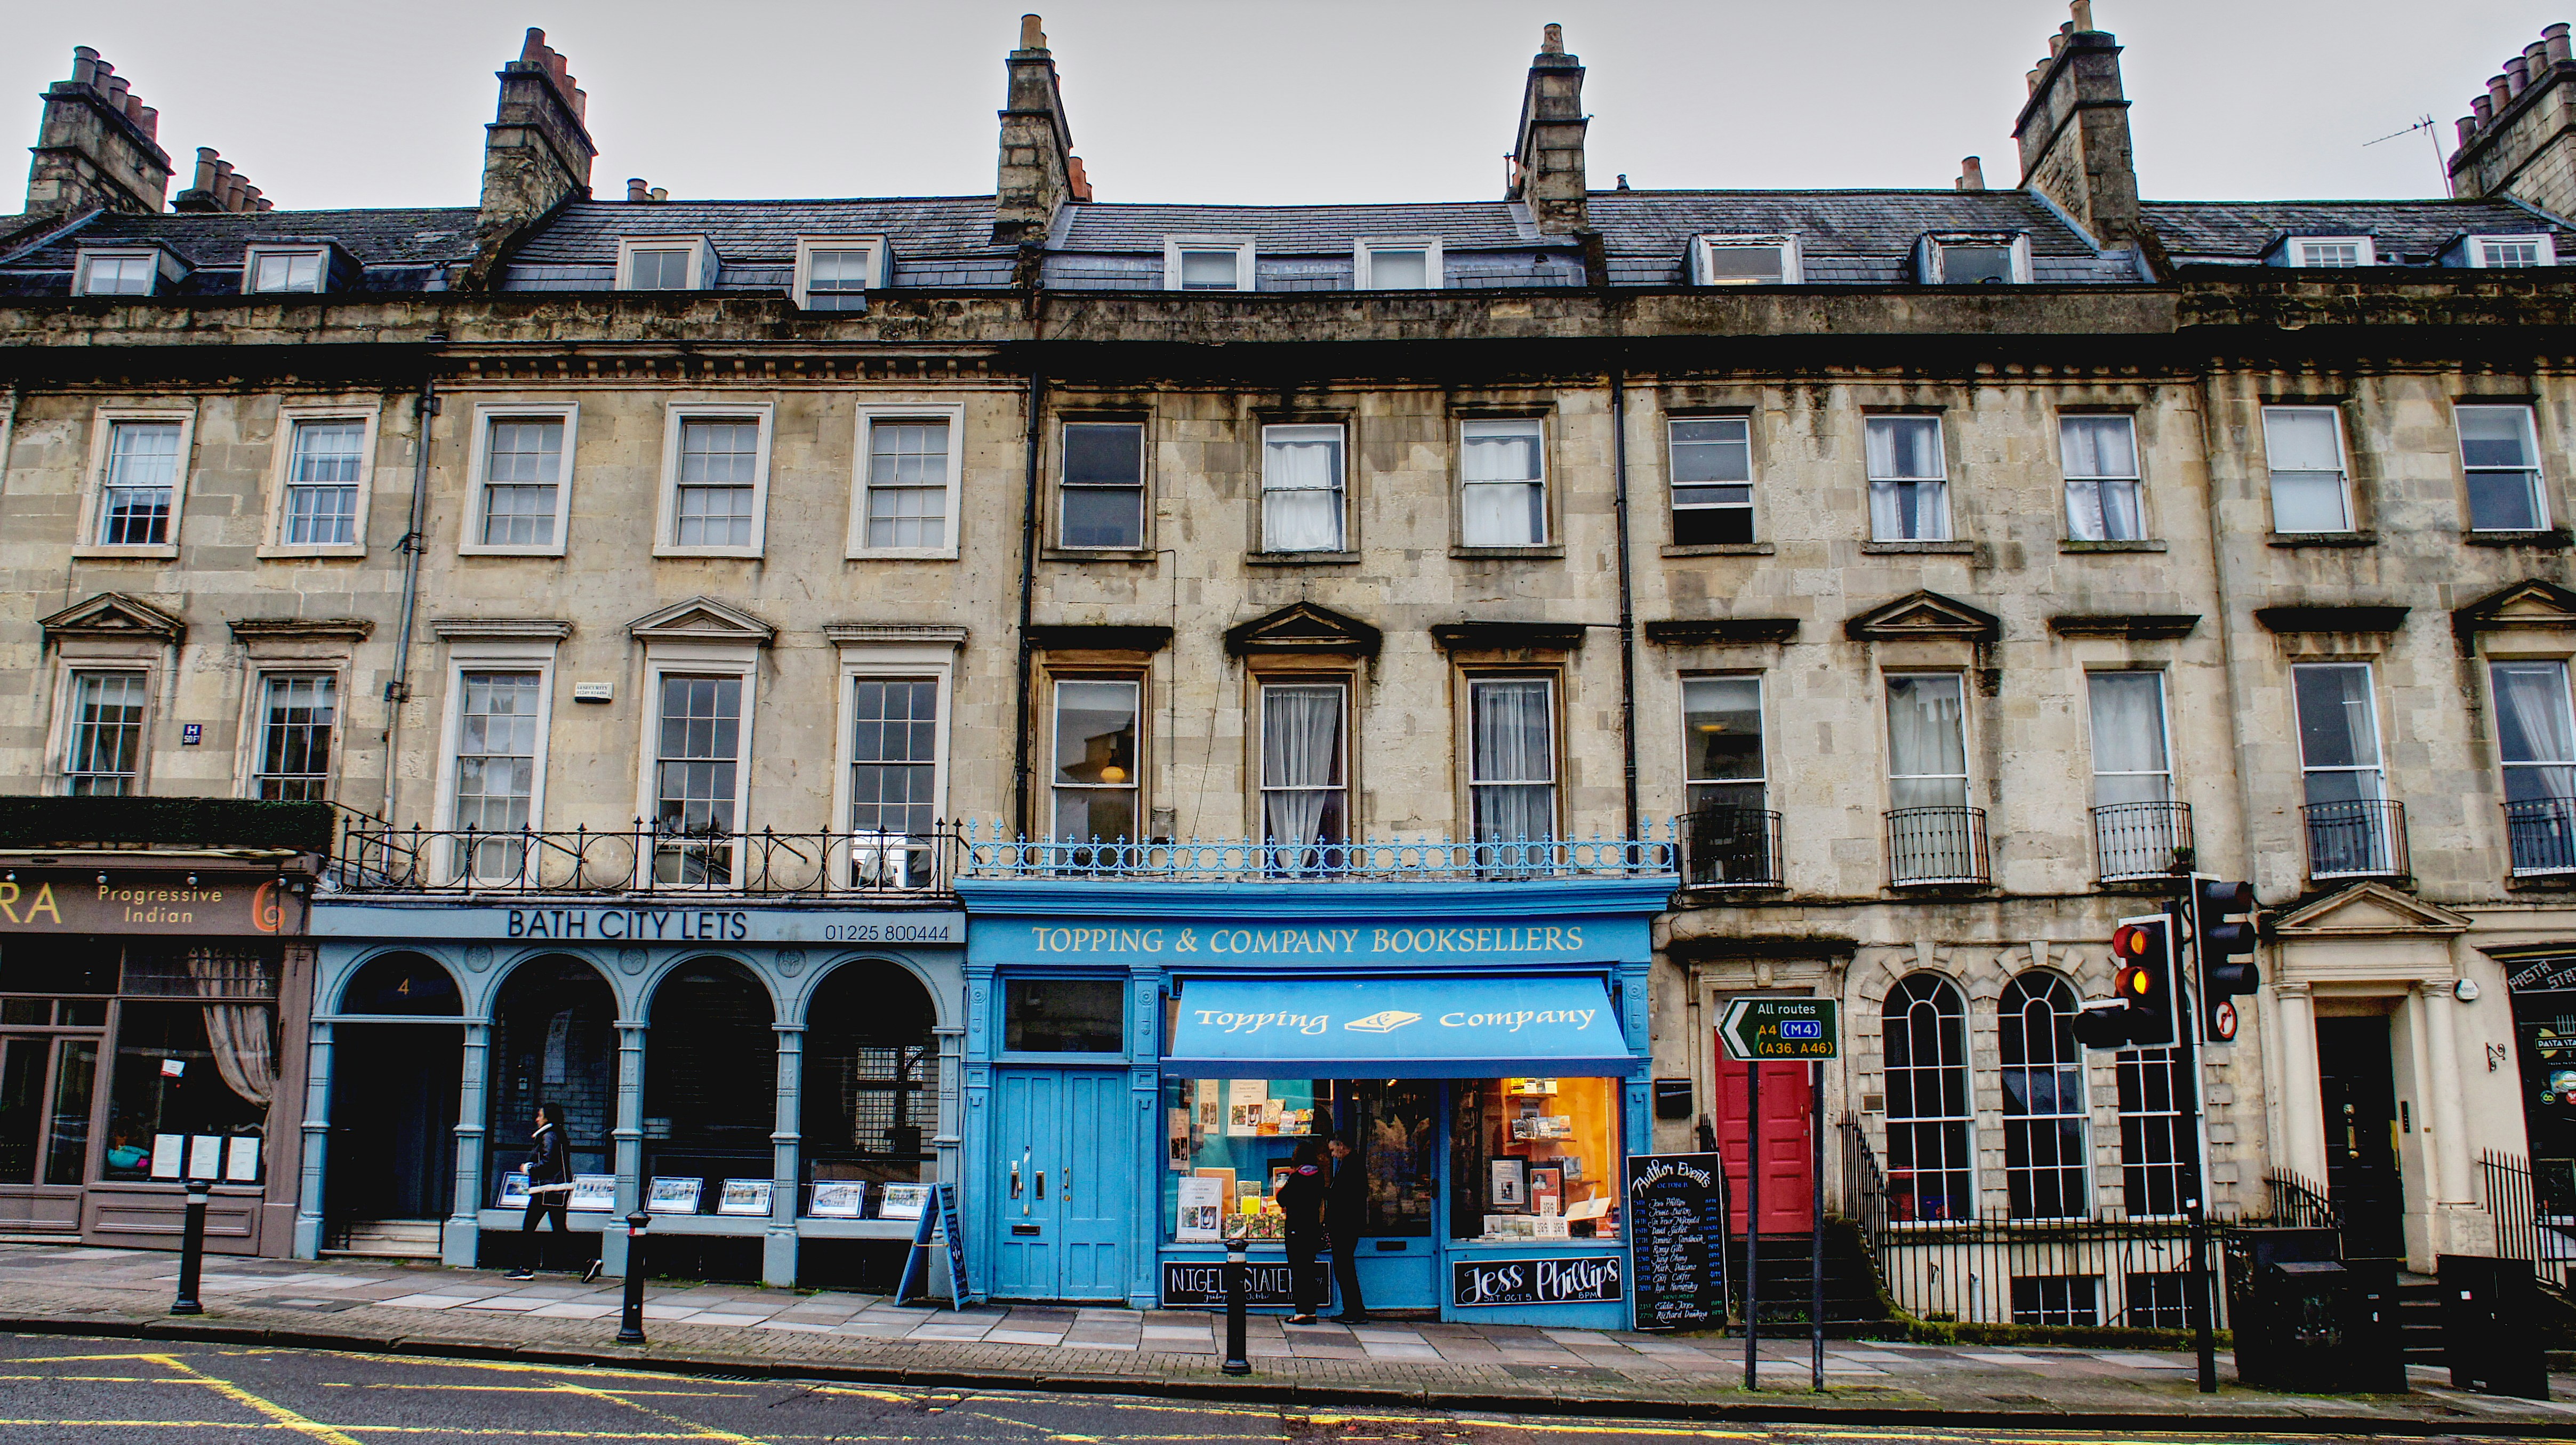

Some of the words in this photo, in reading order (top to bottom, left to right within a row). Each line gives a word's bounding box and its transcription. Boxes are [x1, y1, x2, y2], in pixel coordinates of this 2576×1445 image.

[187, 725, 198, 735] H
[98, 885, 223, 905] Progressive
[125, 907, 193, 923] Indian
[508, 910, 585, 938] BATH
[599, 911, 670, 939] CITY
[682, 911, 747, 940] LETS
[825, 925, 879, 940] 01225
[885, 925, 949, 941] 800444
[1033, 927, 1164, 953] TOPPING
[1175, 928, 1198, 953] &
[1210, 929, 1359, 954] COMPANY
[1371, 927, 1583, 953] BOOKSELLERS
[2508, 960, 2553, 991] PASTA
[397, 977, 410, 995] 4
[1758, 1003, 1775, 1014] All
[1778, 1004, 1816, 1015] routes
[1194, 1010, 1329, 1035] Topping
[1439, 1009, 1595, 1032] Company
[1759, 1025, 1777, 1035] A4
[1784, 1023, 1819, 1036] (M4)
[1800, 1041, 1834, 1055] A46)
[1632, 1159, 1674, 1198] Author
[1677, 1161, 1712, 1188] Events
[1652, 1263, 1673, 1274] Mark
[1172, 1268, 1228, 1293] NIGEL
[1461, 1265, 1525, 1304] Jess
[1537, 1259, 1618, 1300] Phillips
[1483, 1295, 1500, 1303] SAT
[1504, 1294, 1523, 1303] OCT
[1578, 1291, 1598, 1300] 8PM
[1655, 1301, 1674, 1310] Eddie
[1656, 1310, 1682, 1324] Richard
